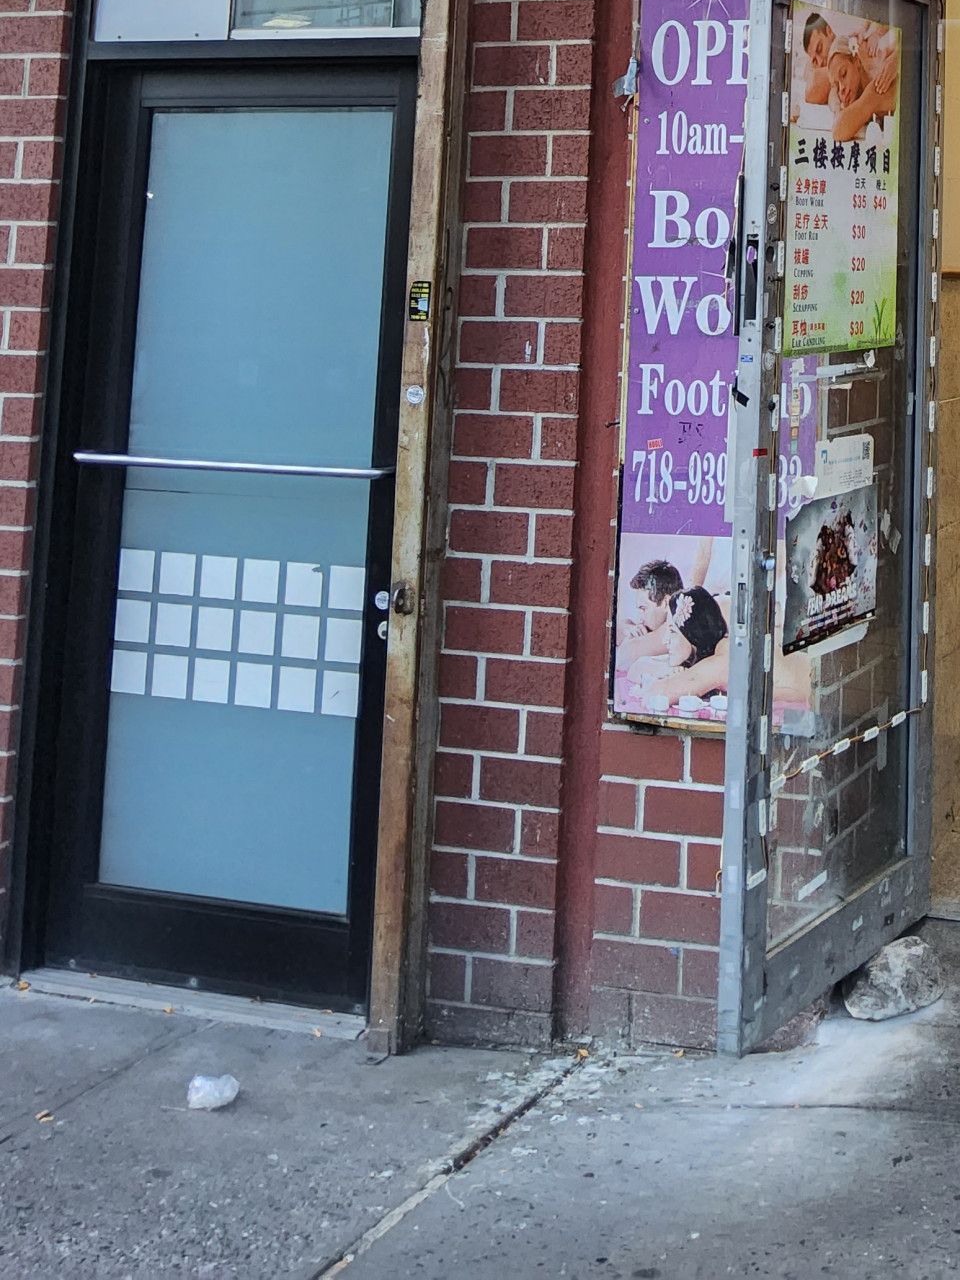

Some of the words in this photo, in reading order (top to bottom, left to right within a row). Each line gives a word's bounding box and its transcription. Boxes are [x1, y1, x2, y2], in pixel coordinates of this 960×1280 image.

[656, 109, 744, 156] 10am-
[853, 193, 867, 210] $35
[873, 195, 887, 212] $40
[648, 190, 730, 249] Bo
[852, 223, 866, 240] $30
[851, 256, 866, 273] $20
[635, 276, 731, 336] Wo
[850, 289, 865, 306] $20
[849, 321, 864, 336] $30
[637, 363, 726, 417] Foot
